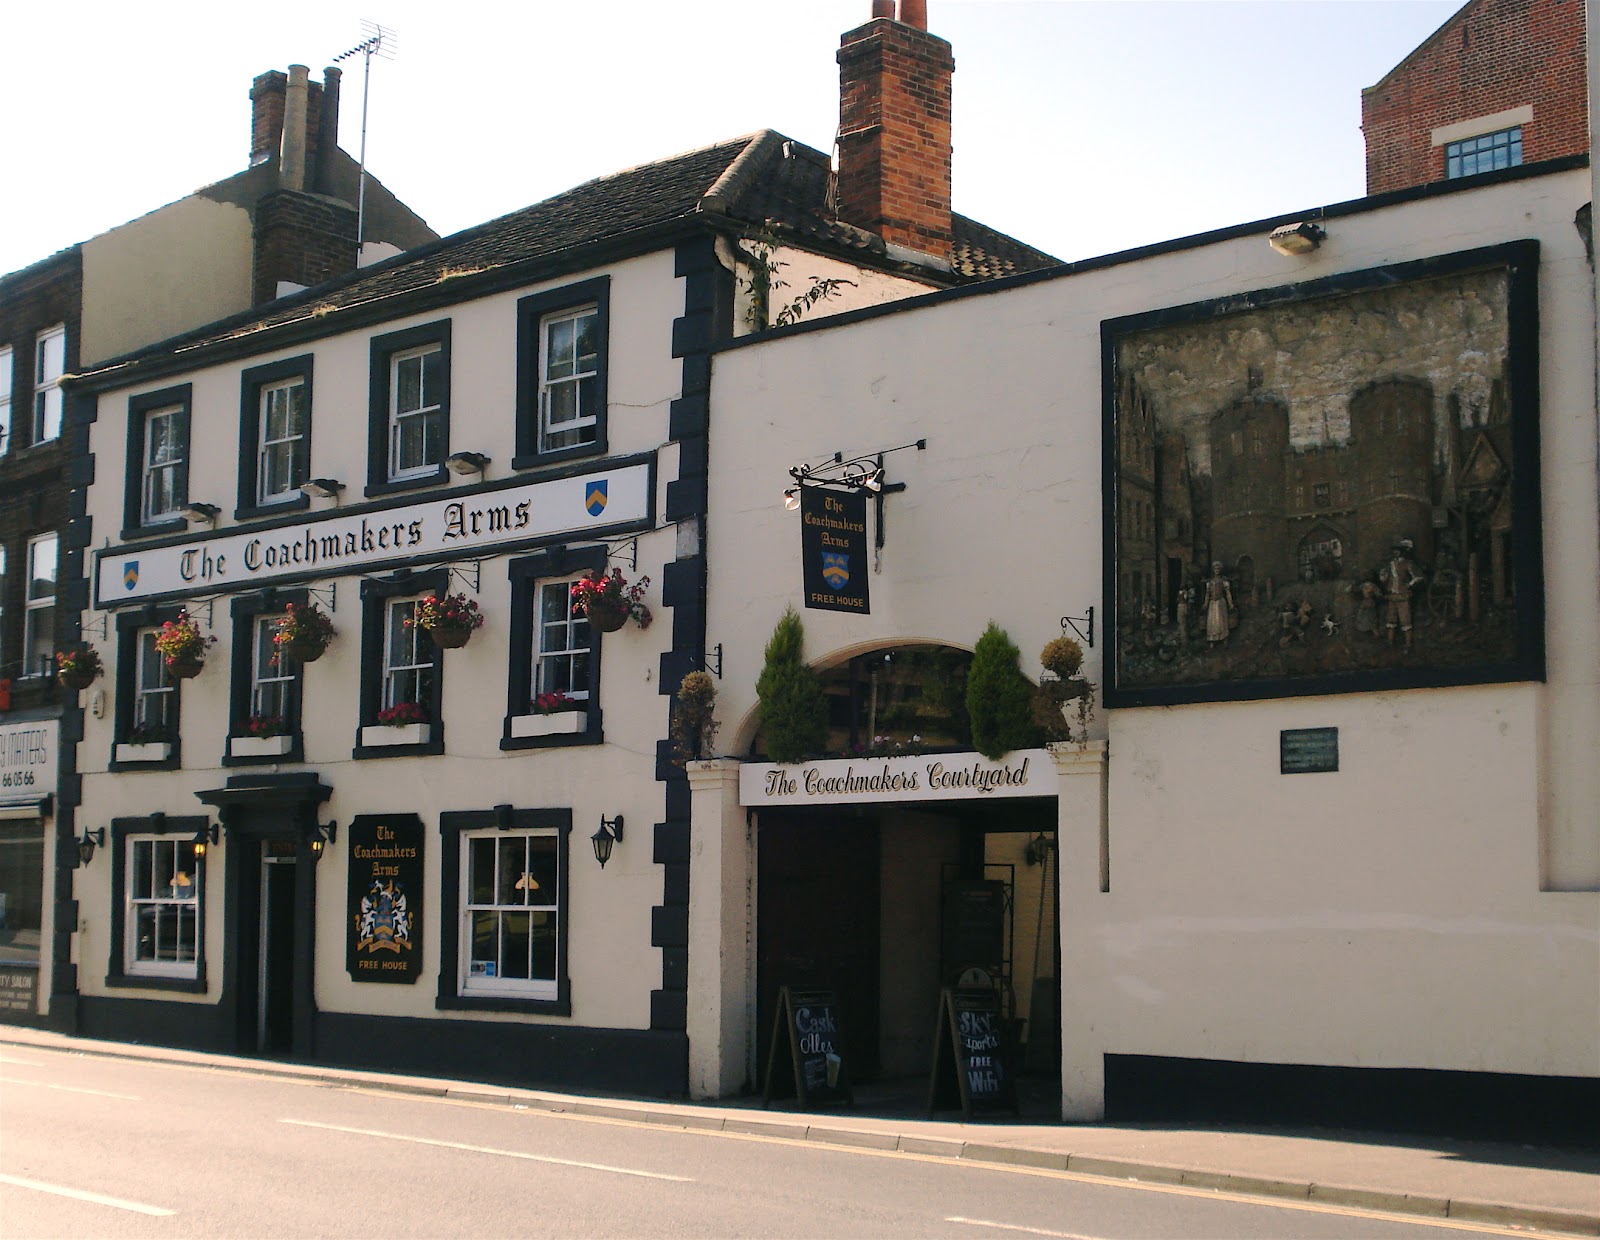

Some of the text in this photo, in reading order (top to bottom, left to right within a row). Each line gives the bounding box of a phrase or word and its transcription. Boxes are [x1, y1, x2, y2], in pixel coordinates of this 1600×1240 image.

[825, 497, 843, 513] The
[804, 511, 864, 533] Coachmakers
[180, 498, 532, 583] The Coachmakers Arms
[821, 531, 849, 548] Arms
[811, 593, 864, 607] FREE HOUSE
[765, 756, 1031, 796] The Coachmakers Courtyard
[376, 825, 395, 841] The
[353, 844, 417, 859] Coachmakers
[372, 861, 400, 877] Arms
[358, 960, 408, 971] FREE HOUSE
[795, 1007, 837, 1033] Cask
[800, 1033, 834, 1054] Ales
[970, 1056, 992, 1068] FREE
